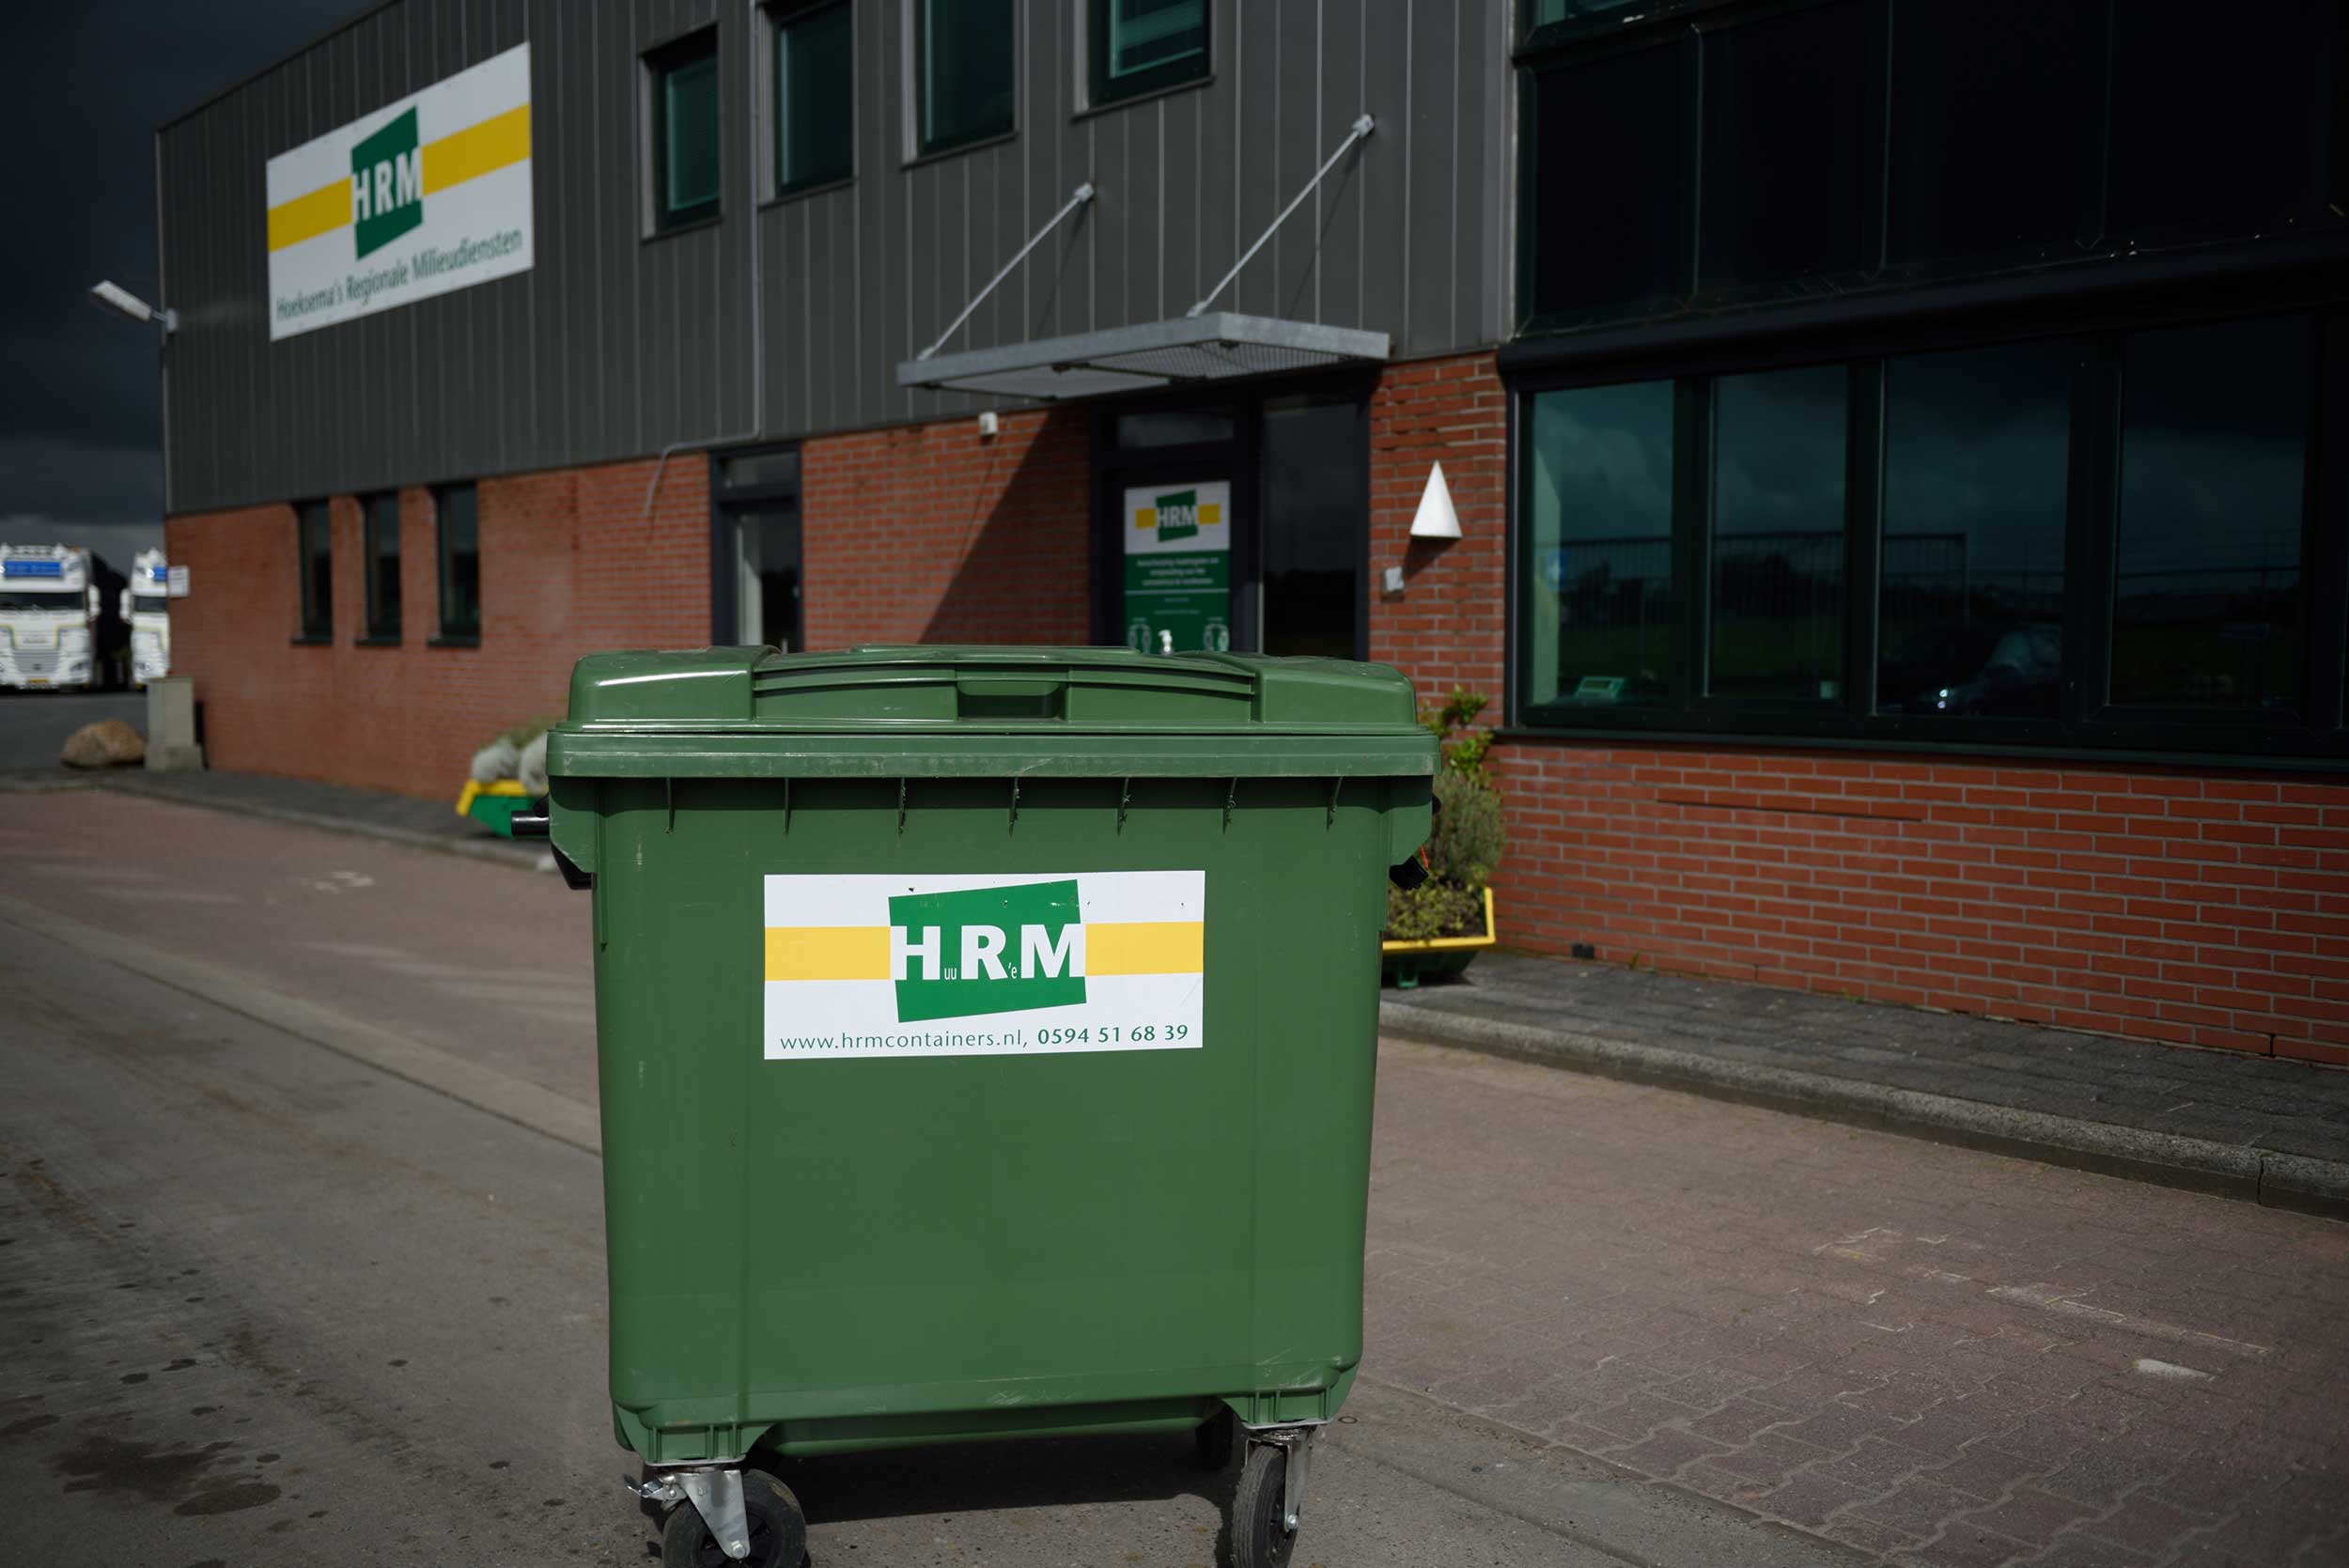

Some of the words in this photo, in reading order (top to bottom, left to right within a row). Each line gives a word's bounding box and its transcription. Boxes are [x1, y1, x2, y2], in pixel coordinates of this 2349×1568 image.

[352, 147, 422, 224] HRM
[276, 279, 343, 319] Hoeksema's
[346, 259, 409, 305] Regionale
[412, 230, 521, 280] Milieudiensten
[1157, 505, 1198, 527] HRM
[780, 1030, 1028, 1050] www.hrmcontainers.nl,
[1037, 1028, 1090, 1046] 0594
[1097, 1026, 1121, 1043] 51
[1130, 1025, 1156, 1042] 68
[1164, 1024, 1189, 1040] 39
